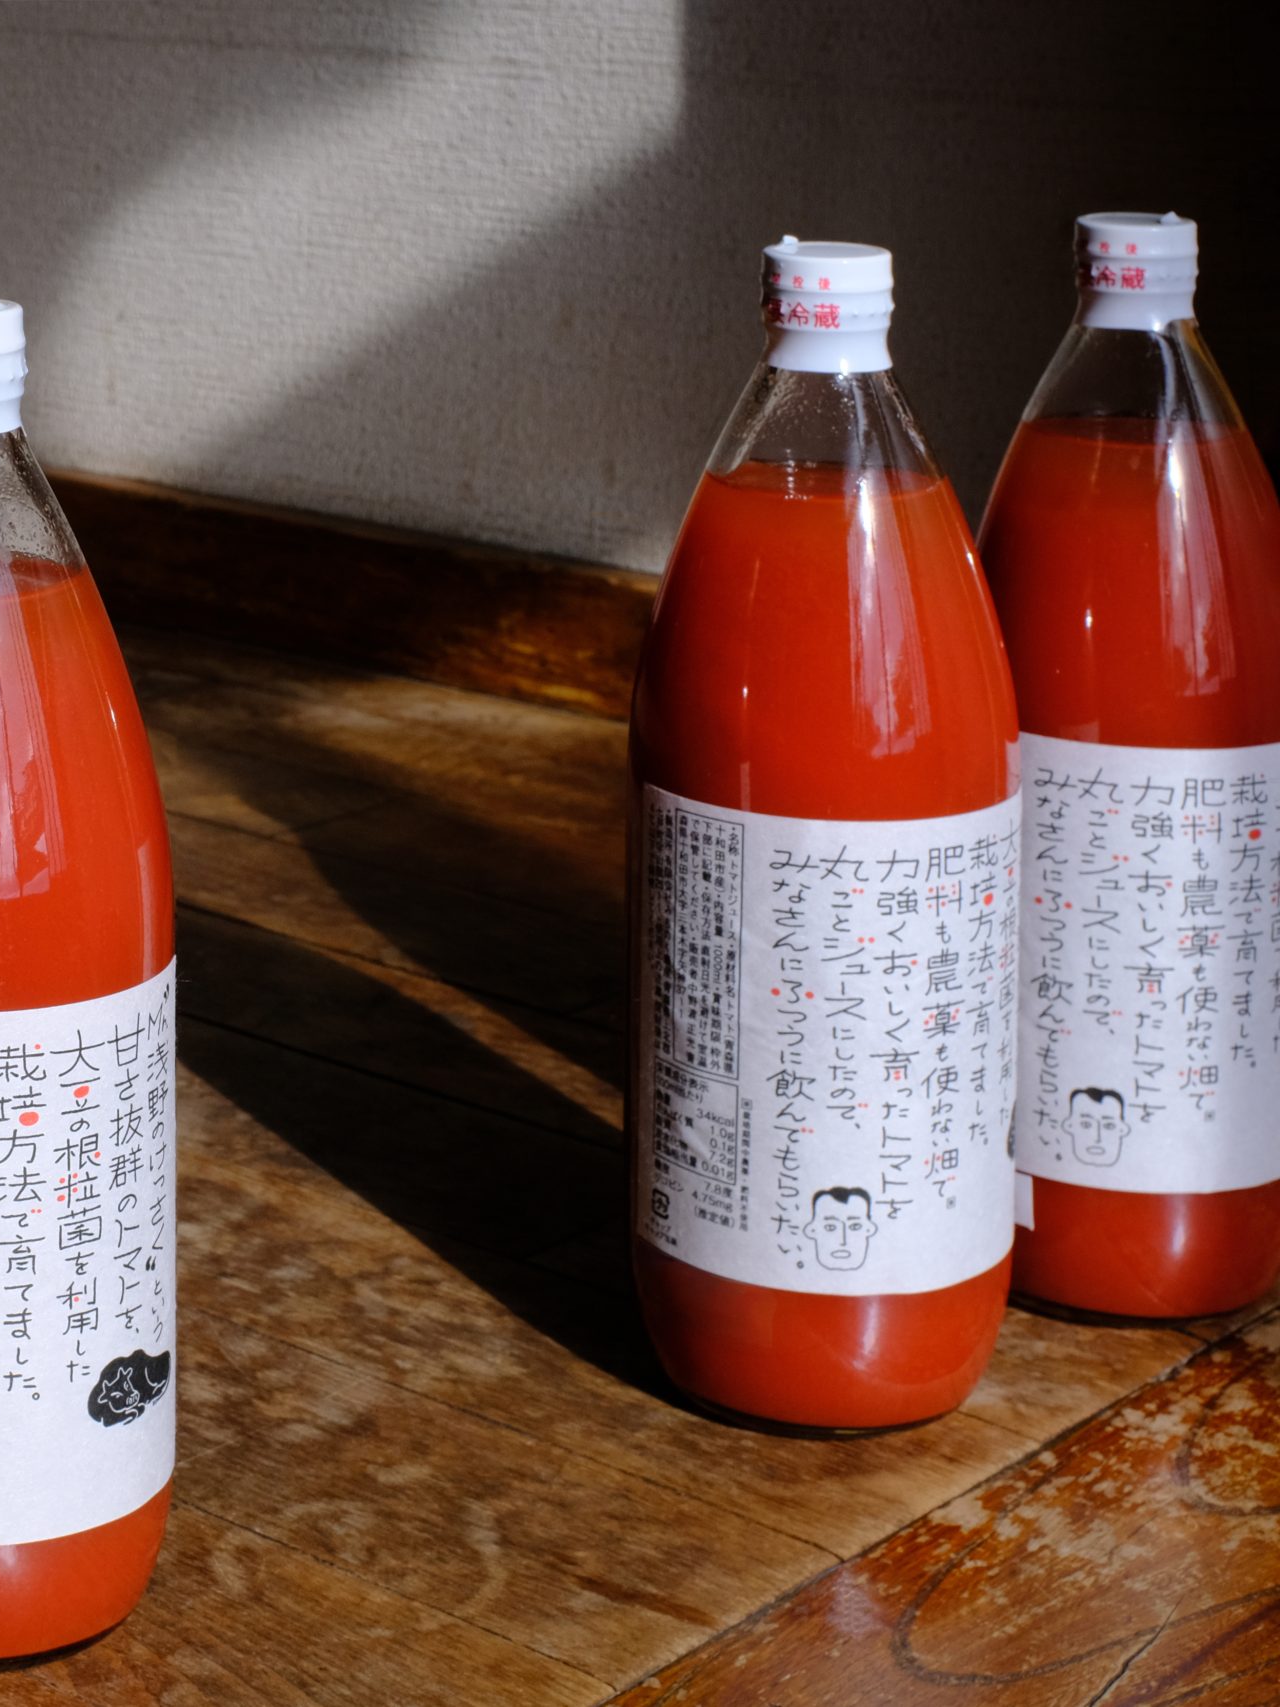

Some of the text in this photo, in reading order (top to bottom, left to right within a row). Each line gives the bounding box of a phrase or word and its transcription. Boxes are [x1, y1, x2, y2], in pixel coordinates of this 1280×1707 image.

[48, 1029, 107, 1384] 大豆の根粒菌を利用した
[106, 1012, 146, 1336] 甘さ抜群のトマトを、
